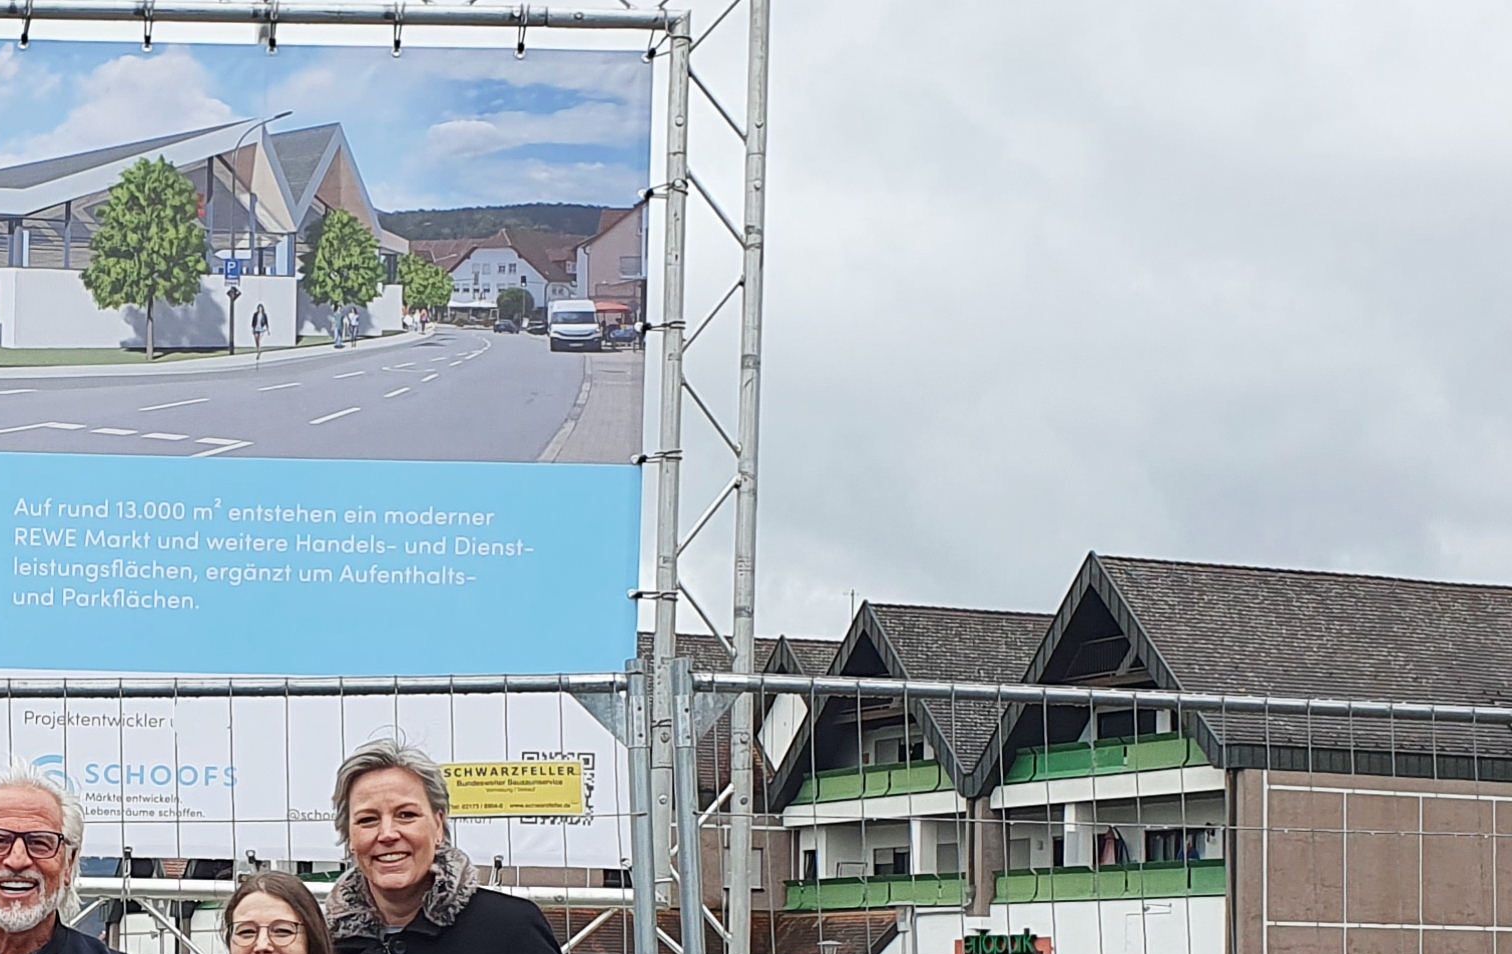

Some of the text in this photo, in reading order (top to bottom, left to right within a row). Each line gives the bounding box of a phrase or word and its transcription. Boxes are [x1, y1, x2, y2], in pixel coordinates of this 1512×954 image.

[13, 497, 52, 517] Auf
[58, 498, 109, 518] rund
[116, 500, 186, 520] 13.000
[228, 503, 337, 523] entstehen
[343, 505, 377, 524] ein
[384, 506, 495, 526] moderner
[14, 527, 534, 556] REWE Markt und weitere Handels- und Dienst-
[13, 556, 477, 586] leistungsflächen, ergänzt um Aufenthalts-
[12, 587, 200, 610] und Parkflächen.
[24, 709, 166, 730] Projektentwickler
[84, 763, 238, 787] SCHOOFS
[443, 766, 576, 778] SCHWARZFELLER
[85, 792, 122, 803] Märkte
